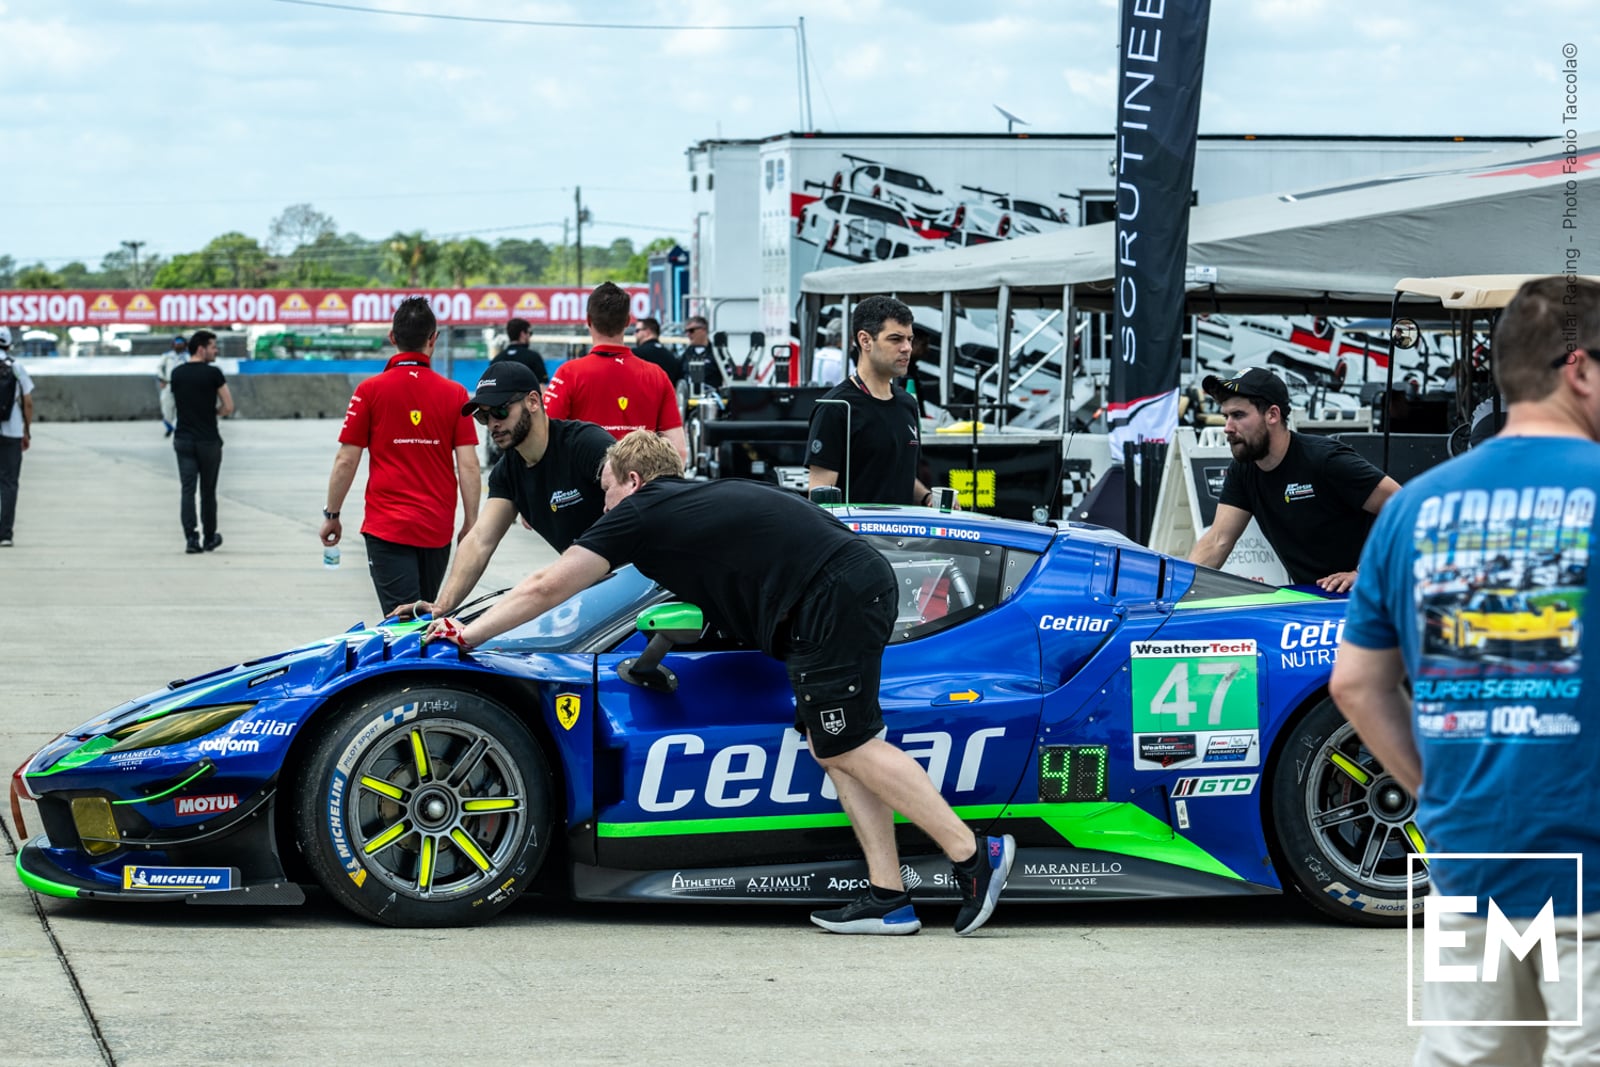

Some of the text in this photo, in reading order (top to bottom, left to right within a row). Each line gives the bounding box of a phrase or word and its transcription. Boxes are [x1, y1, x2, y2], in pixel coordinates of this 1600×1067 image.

[0, 294, 85, 322] ISSION
[160, 293, 276, 322] MISSION
[861, 523, 980, 540] SERNAGIOTTO FUOCO
[1227, 550, 1276, 565] SPECTION
[1039, 615, 1113, 633] Cetilar
[1280, 619, 1346, 650] Ceti
[1135, 642, 1252, 655] WeatherTech
[1281, 648, 1339, 669] NUTRI
[1150, 662, 1241, 727] 47
[229, 719, 297, 736] Cetilar
[199, 736, 259, 756] rotiform
[343, 724, 380, 767] PILOT SPORT
[110, 749, 161, 761] MARANELLO
[637, 726, 1007, 813] Cetar
[1042, 748, 1105, 796] 47
[1199, 778, 1251, 793] GTD
[178, 795, 238, 814] MOTUL
[330, 777, 351, 858] MICHELIN
[1024, 862, 1122, 875] MARANELLO
[150, 874, 221, 885] MICHELIN
[747, 875, 810, 888] AZIMUT
[1050, 877, 1097, 886] VILLAGE
[1374, 903, 1404, 911] SPORT
